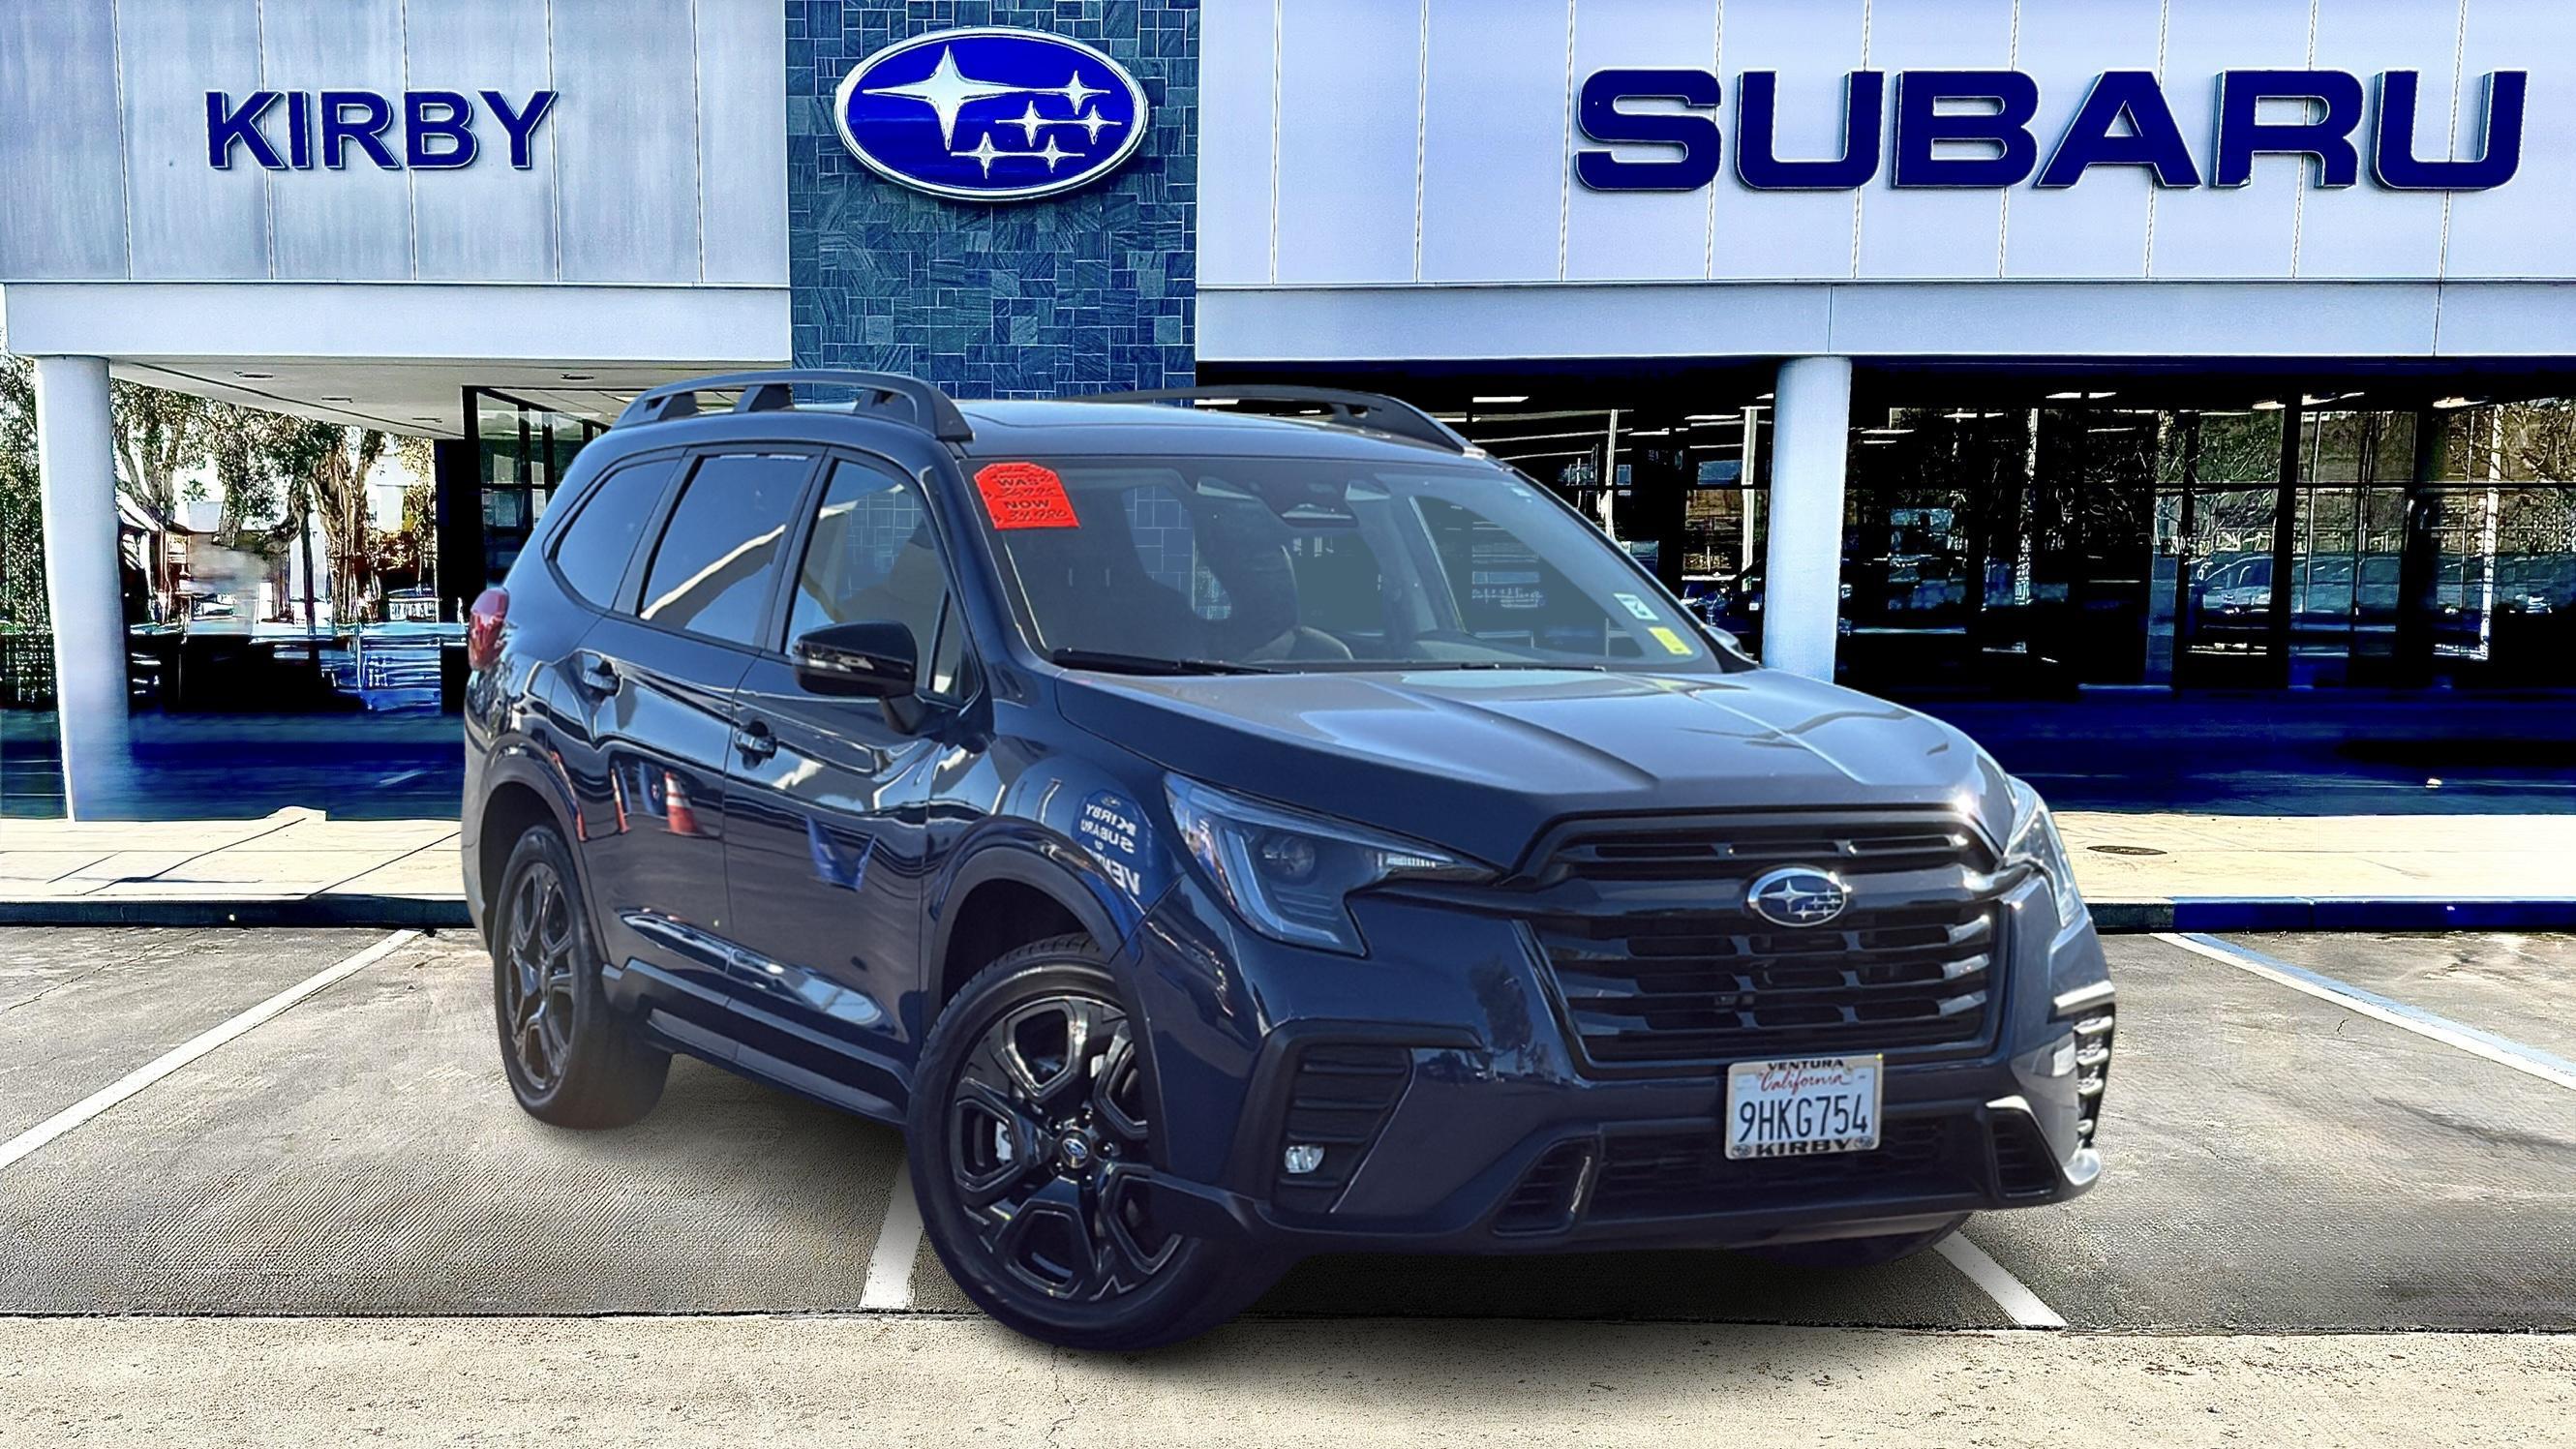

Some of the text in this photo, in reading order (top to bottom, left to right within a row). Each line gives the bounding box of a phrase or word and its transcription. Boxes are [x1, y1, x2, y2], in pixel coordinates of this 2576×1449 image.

[205, 89, 559, 170] KIRBY
[1575, 69, 2528, 191] SUBARU
[997, 478, 1040, 487] WAS
[1004, 499, 1049, 509] NOW
[1767, 1059, 1844, 1071] VENTURA
[1760, 1071, 1851, 1096] California
[1738, 1094, 1868, 1143] 9HKG754
[1755, 1138, 1852, 1157] KIRBY
